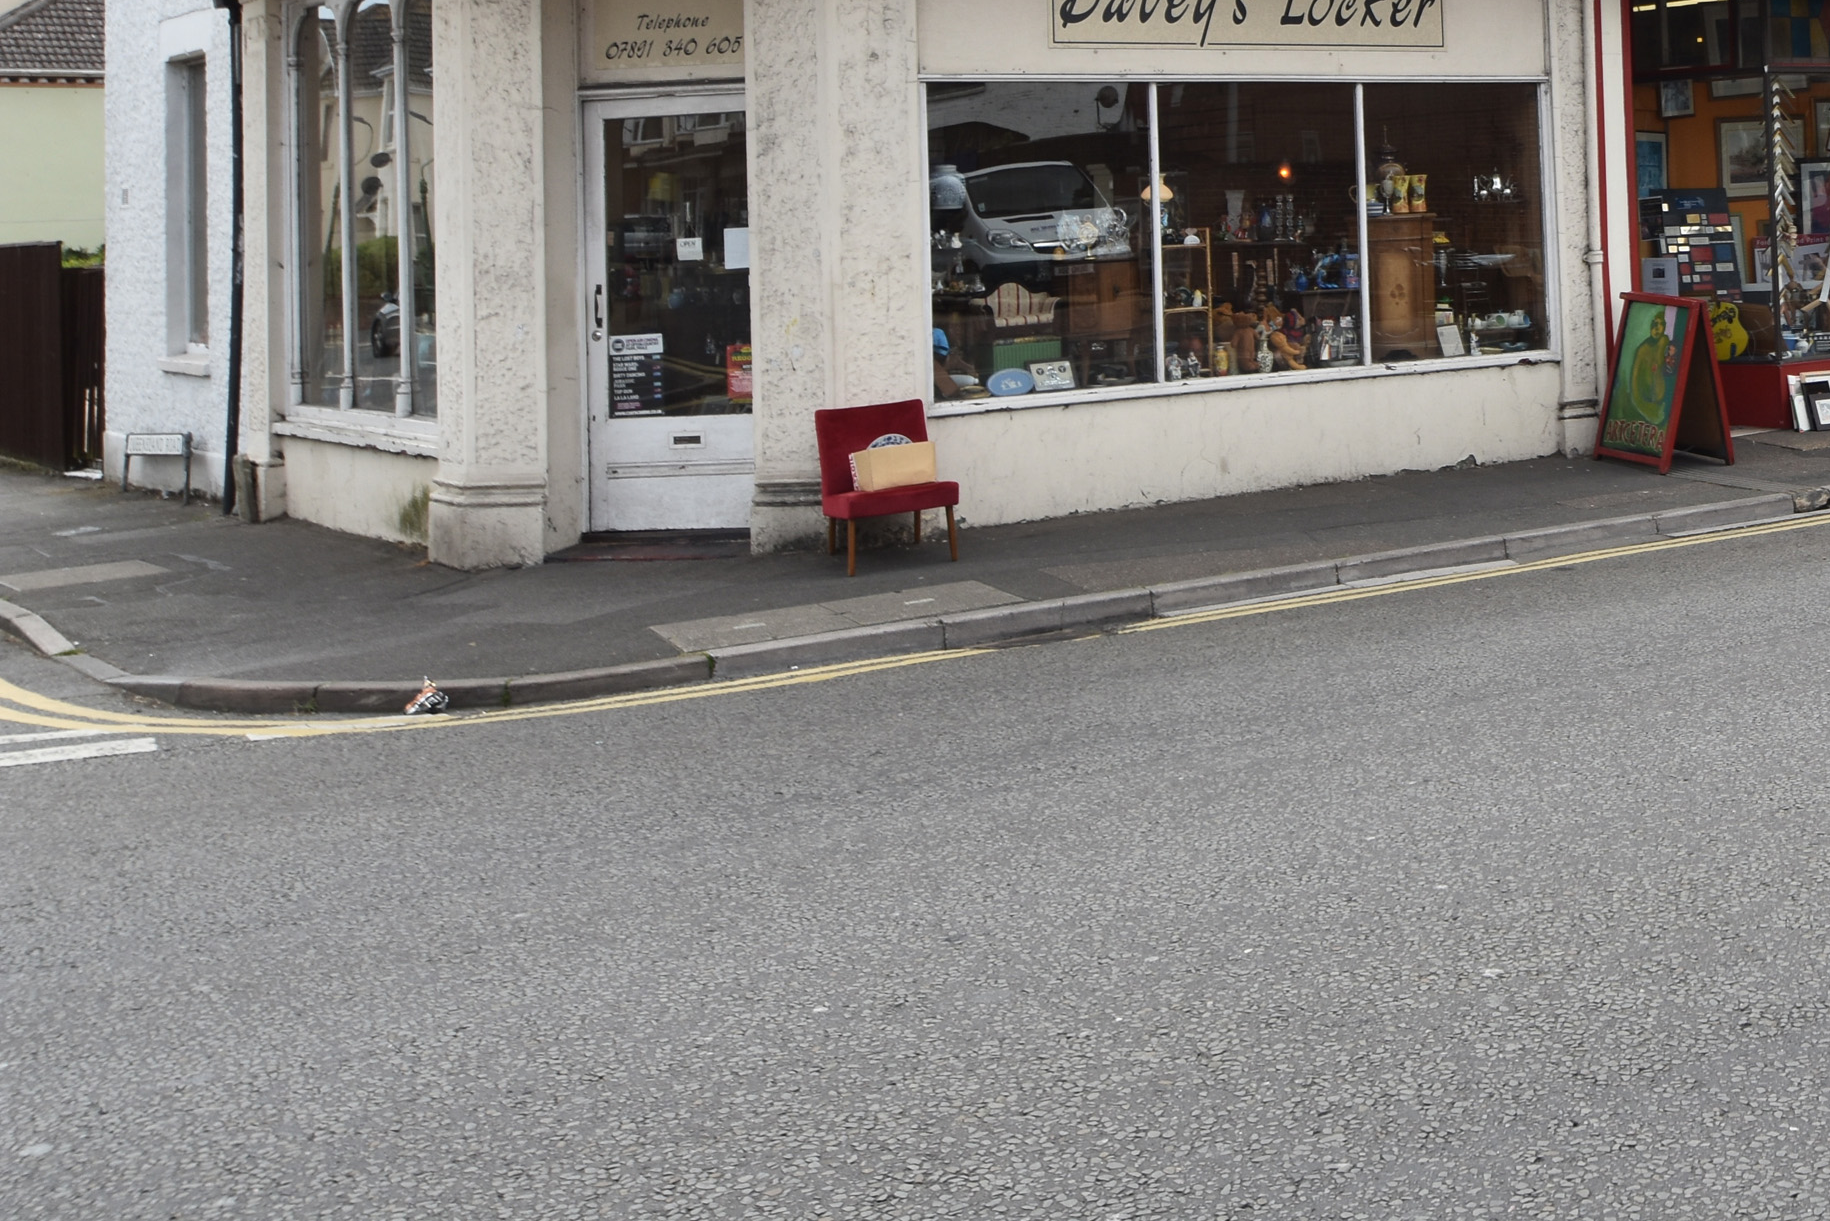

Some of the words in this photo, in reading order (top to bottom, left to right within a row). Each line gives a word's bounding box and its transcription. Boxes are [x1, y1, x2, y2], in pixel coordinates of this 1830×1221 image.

[637, 13, 709, 33] Telephone
[605, 40, 654, 60] 07891
[663, 38, 698, 57] 340
[705, 36, 743, 55] 605
[680, 240, 696, 248] OPEN
[1604, 419, 1664, 452] ARTCETERA
